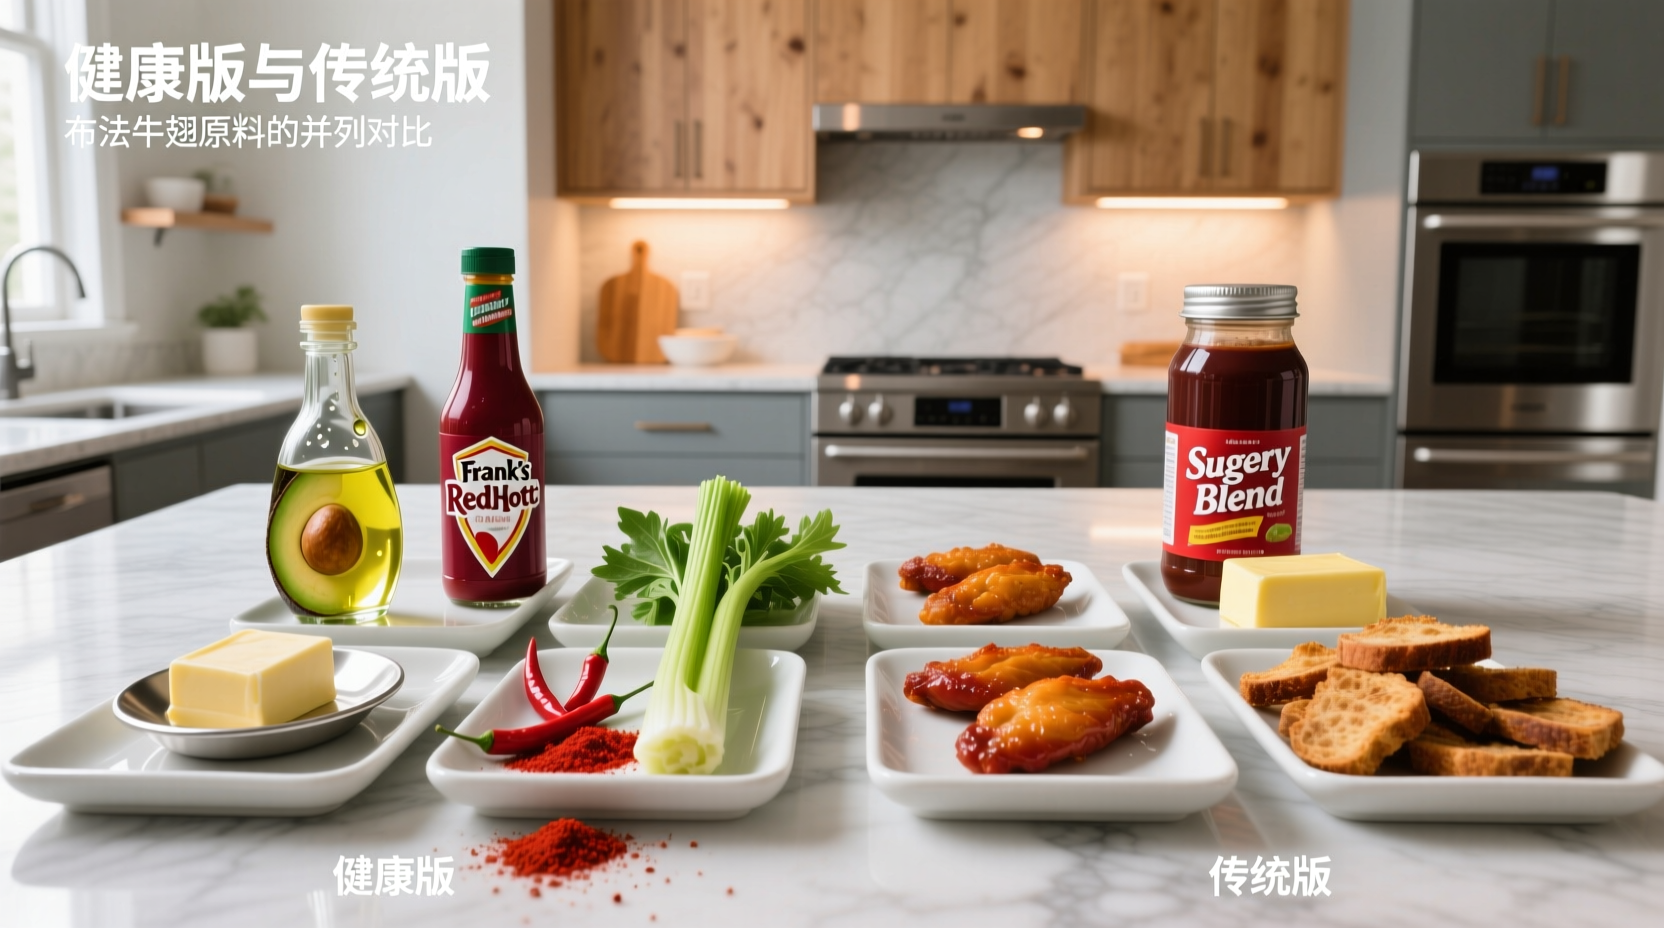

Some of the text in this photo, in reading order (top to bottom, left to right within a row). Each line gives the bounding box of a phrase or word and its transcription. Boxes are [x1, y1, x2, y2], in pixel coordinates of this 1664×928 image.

[460, 459, 530, 483] Frank's
[1185, 446, 1292, 485] Sugery
[447, 483, 539, 516] RedHott
[1193, 476, 1285, 516] Blend
